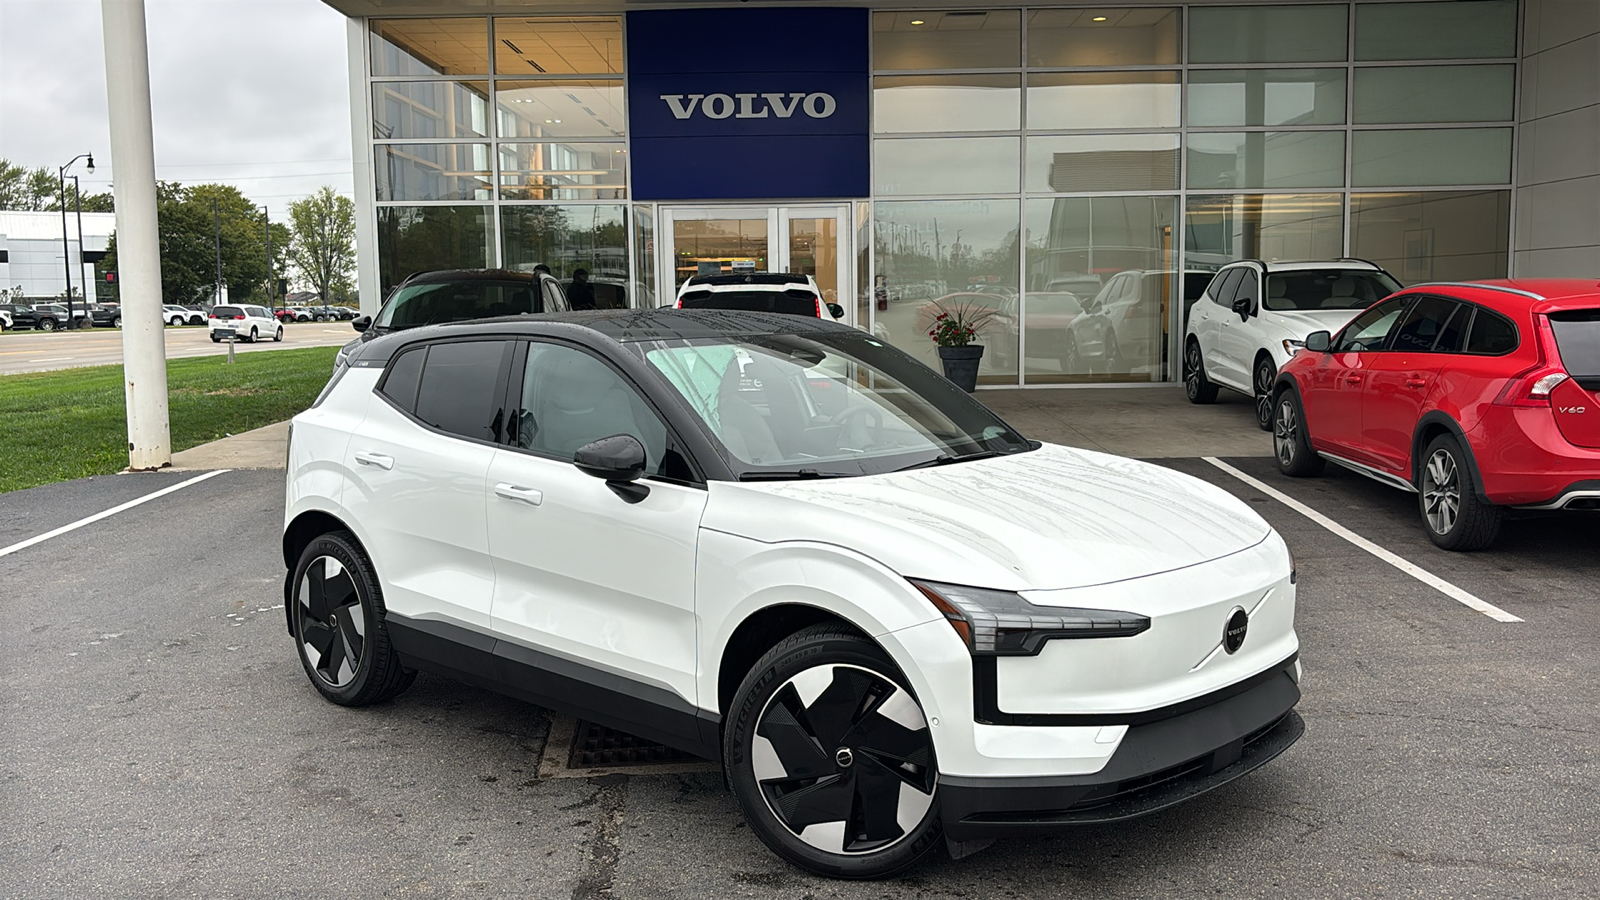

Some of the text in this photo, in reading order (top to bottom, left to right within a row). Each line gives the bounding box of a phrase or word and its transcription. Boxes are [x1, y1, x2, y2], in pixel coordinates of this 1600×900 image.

[659, 92, 837, 119] VOLVO
[876, 221, 946, 234] Cars LLC
[1558, 406, 1586, 414] V60
[326, 543, 355, 572] MICHELIN
[1227, 625, 1247, 637] VOLVO
[735, 670, 774, 743] MICHELIN
